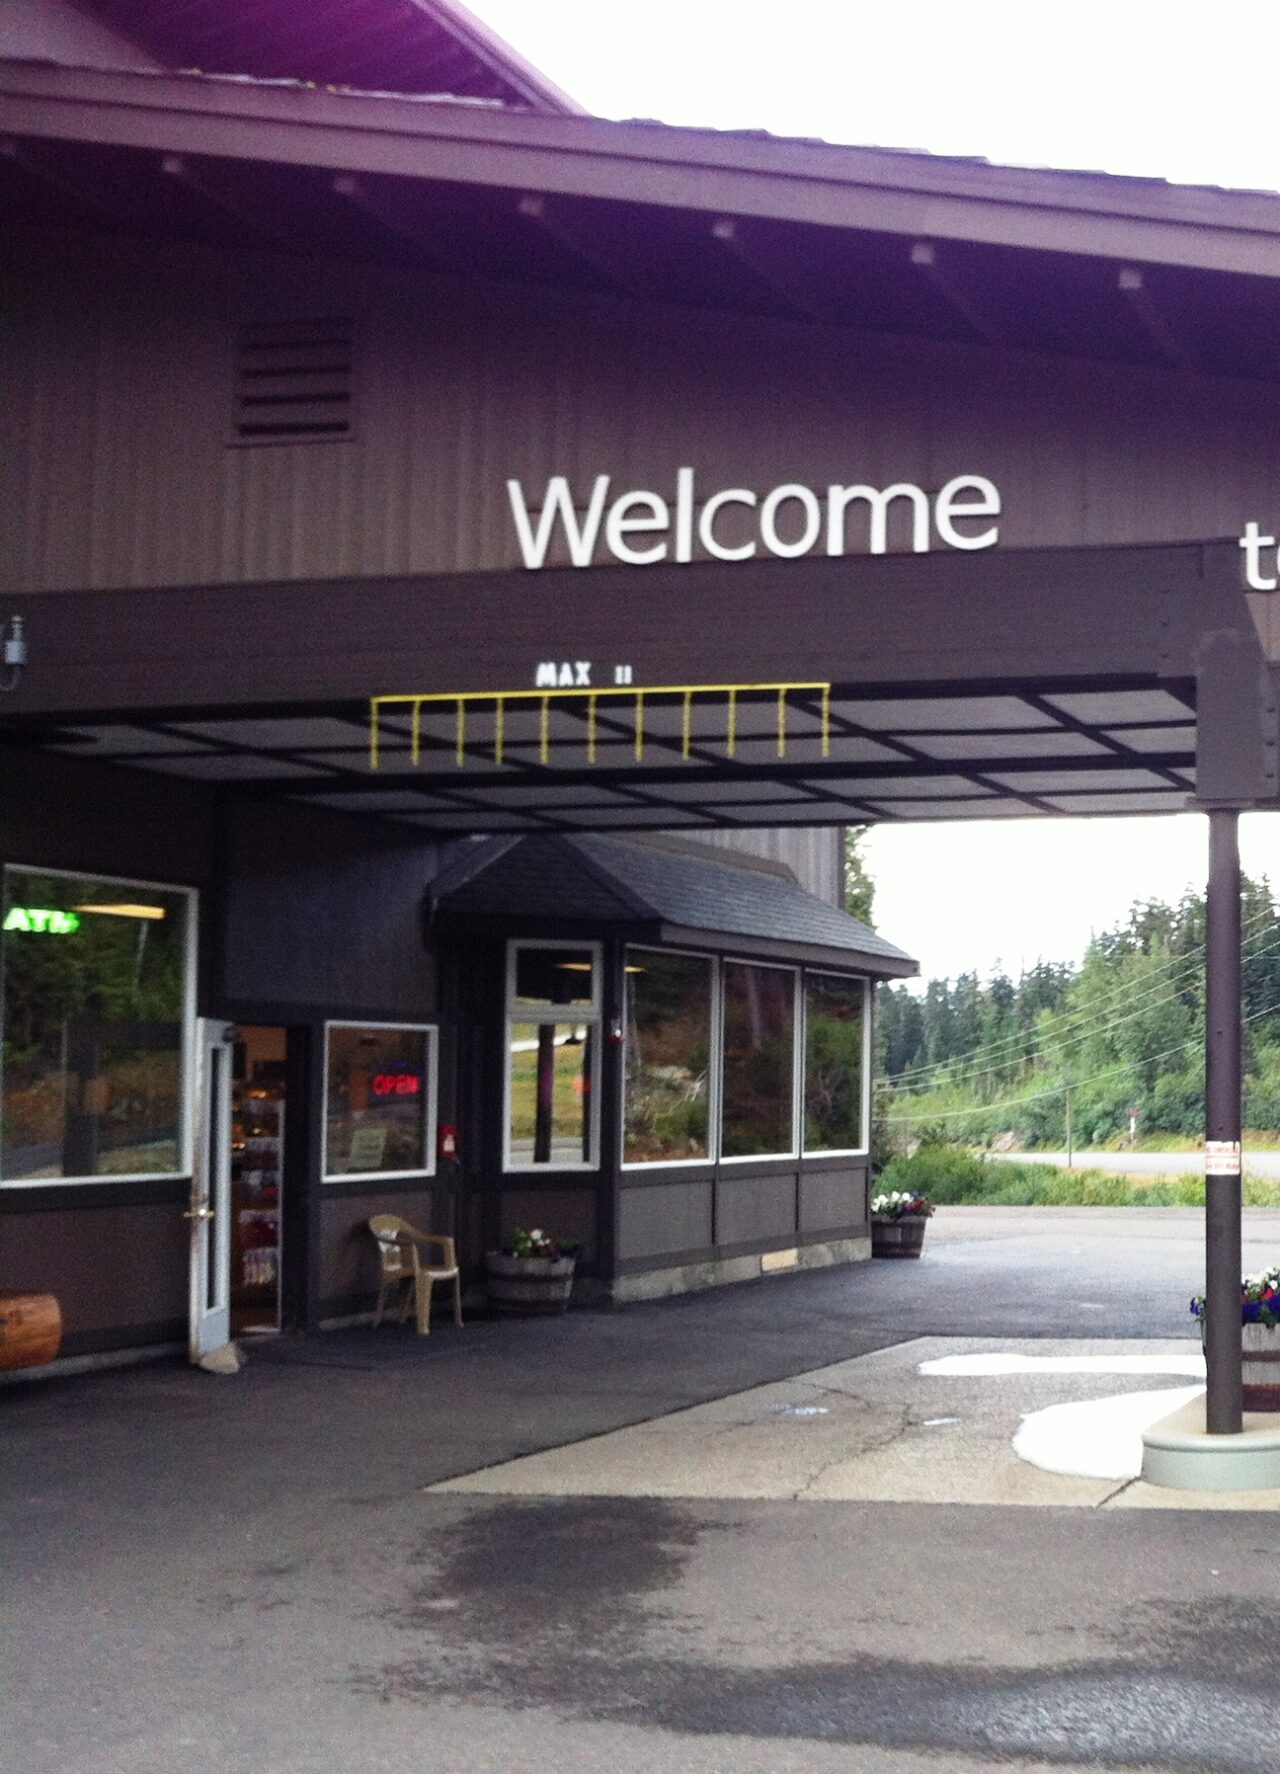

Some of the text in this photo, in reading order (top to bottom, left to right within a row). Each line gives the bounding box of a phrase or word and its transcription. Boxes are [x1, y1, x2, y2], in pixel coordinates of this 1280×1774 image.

[506, 466, 1003, 571] Welcome
[536, 661, 632, 687] MAX 11
[373, 1074, 420, 1095] OPEN
